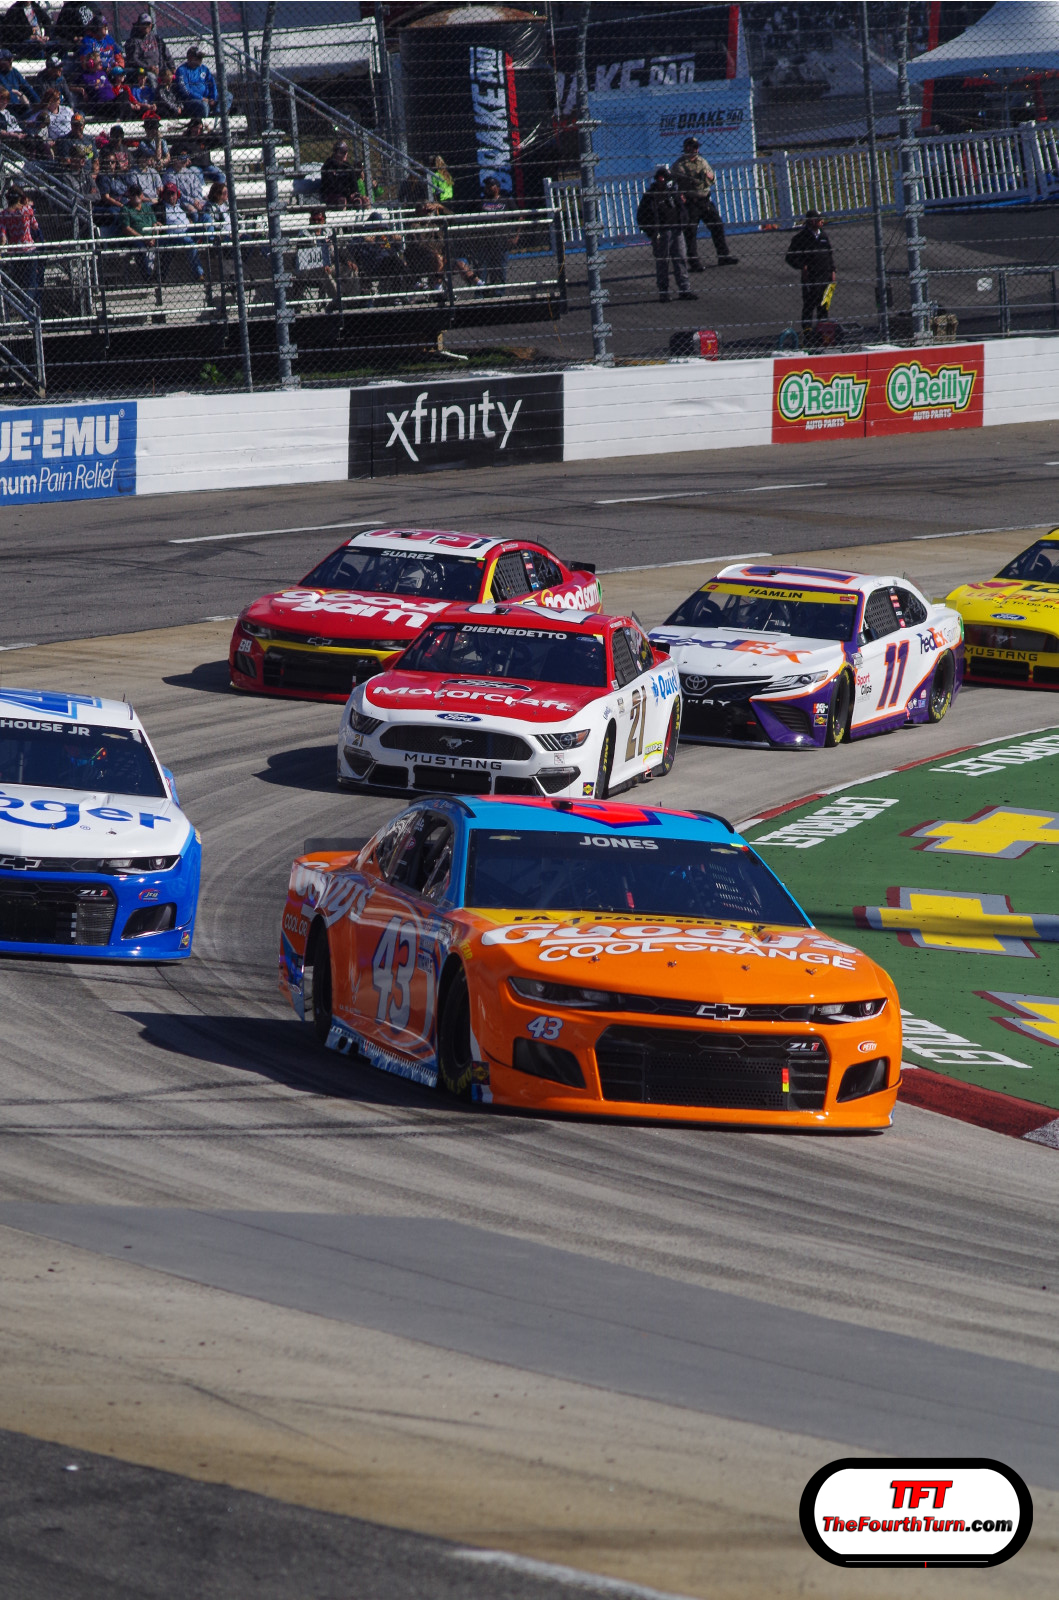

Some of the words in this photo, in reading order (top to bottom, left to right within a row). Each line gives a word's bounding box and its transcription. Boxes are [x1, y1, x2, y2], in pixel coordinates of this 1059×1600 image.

[678, 109, 725, 129] BRAKE
[779, 373, 868, 419] O'Reilly
[888, 364, 975, 411] O'Reilly
[805, 419, 823, 430] AUTO
[823, 417, 845, 429] PARTS
[913, 410, 930, 421] AUTO
[931, 408, 952, 419] PARTS
[386, 390, 522, 462] xfinity
[39, 466, 73, 493] Pain
[74, 459, 119, 490] Relief
[381, 549, 435, 561] SUAREZ
[748, 588, 803, 599] HAMLIN
[461, 624, 568, 640] DIBENEDETTO
[916, 627, 948, 655] FedEx
[964, 645, 1038, 662] MUSTANG
[875, 639, 910, 712] 11
[68, 726, 91, 737] JR
[624, 685, 647, 763] 21
[353, 734, 365, 747] 21
[404, 752, 503, 771] MUSTANG
[579, 835, 660, 850] JONES
[538, 941, 666, 962] COOL
[372, 915, 418, 1034] 43
[526, 1015, 564, 1041] 43
[788, 1042, 820, 1052] ZL1
